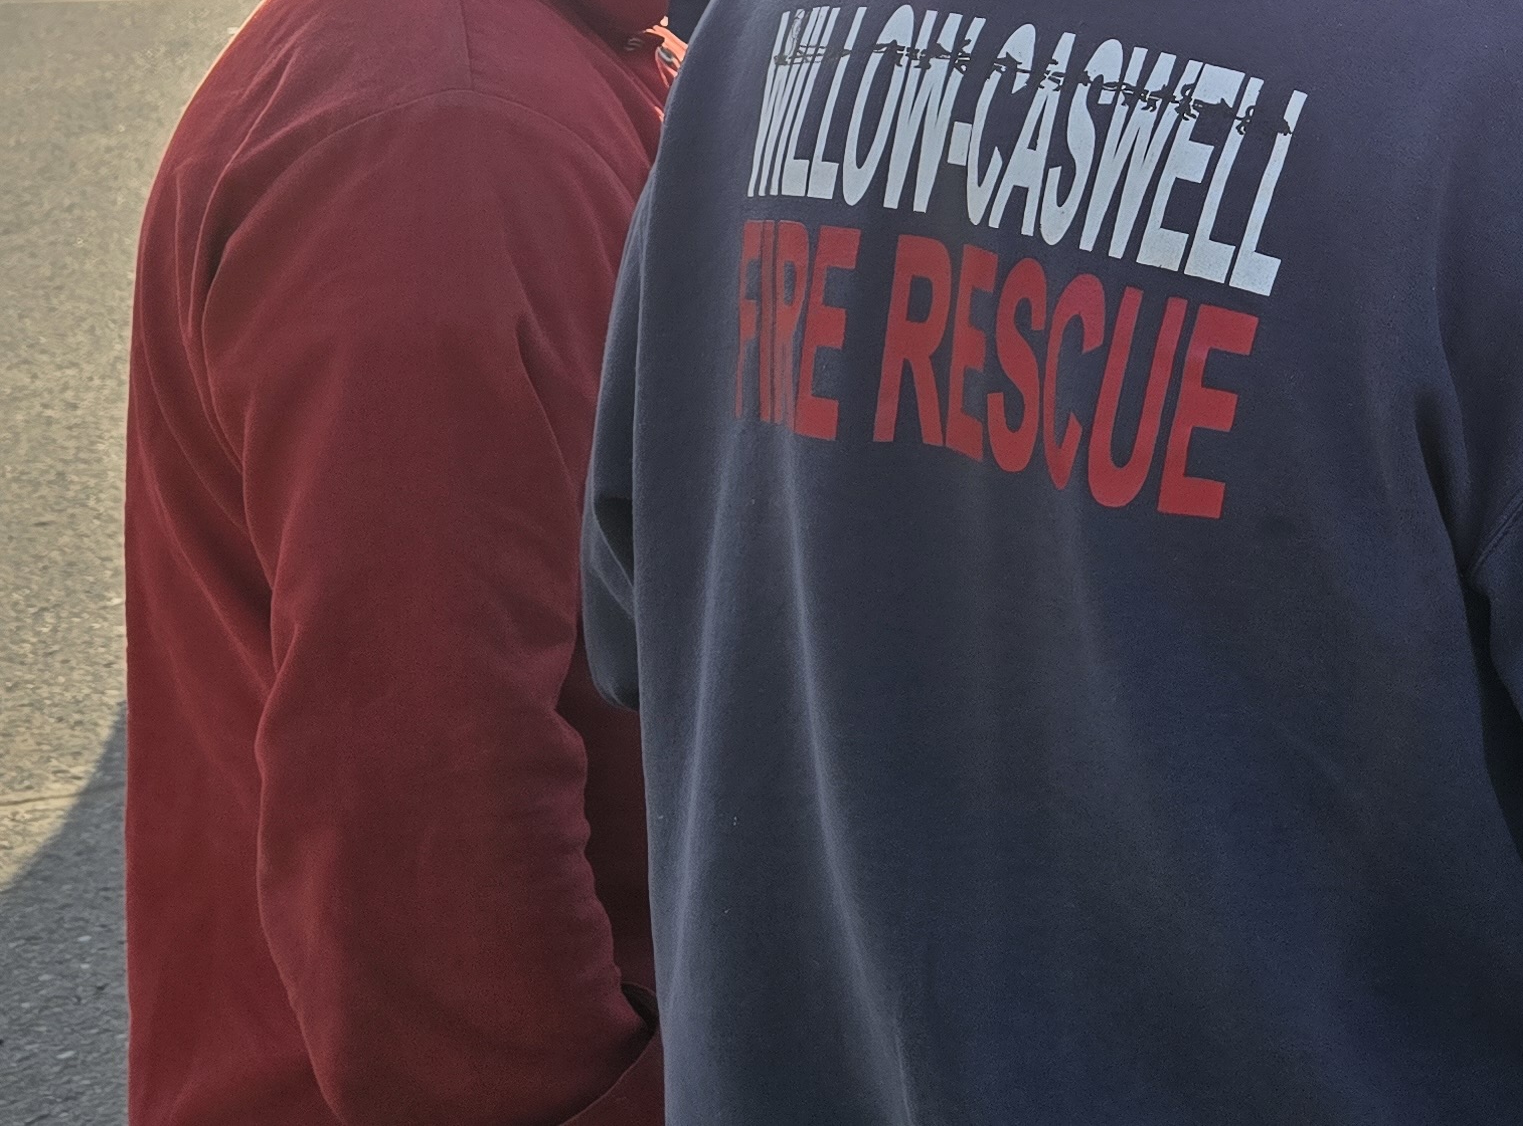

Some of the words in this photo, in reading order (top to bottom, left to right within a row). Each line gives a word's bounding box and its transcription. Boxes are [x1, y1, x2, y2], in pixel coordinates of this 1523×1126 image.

[748, 4, 1308, 296] WILLOW-CASWELL
[735, 219, 861, 441] FIRE
[874, 234, 1259, 519] RESCUE
